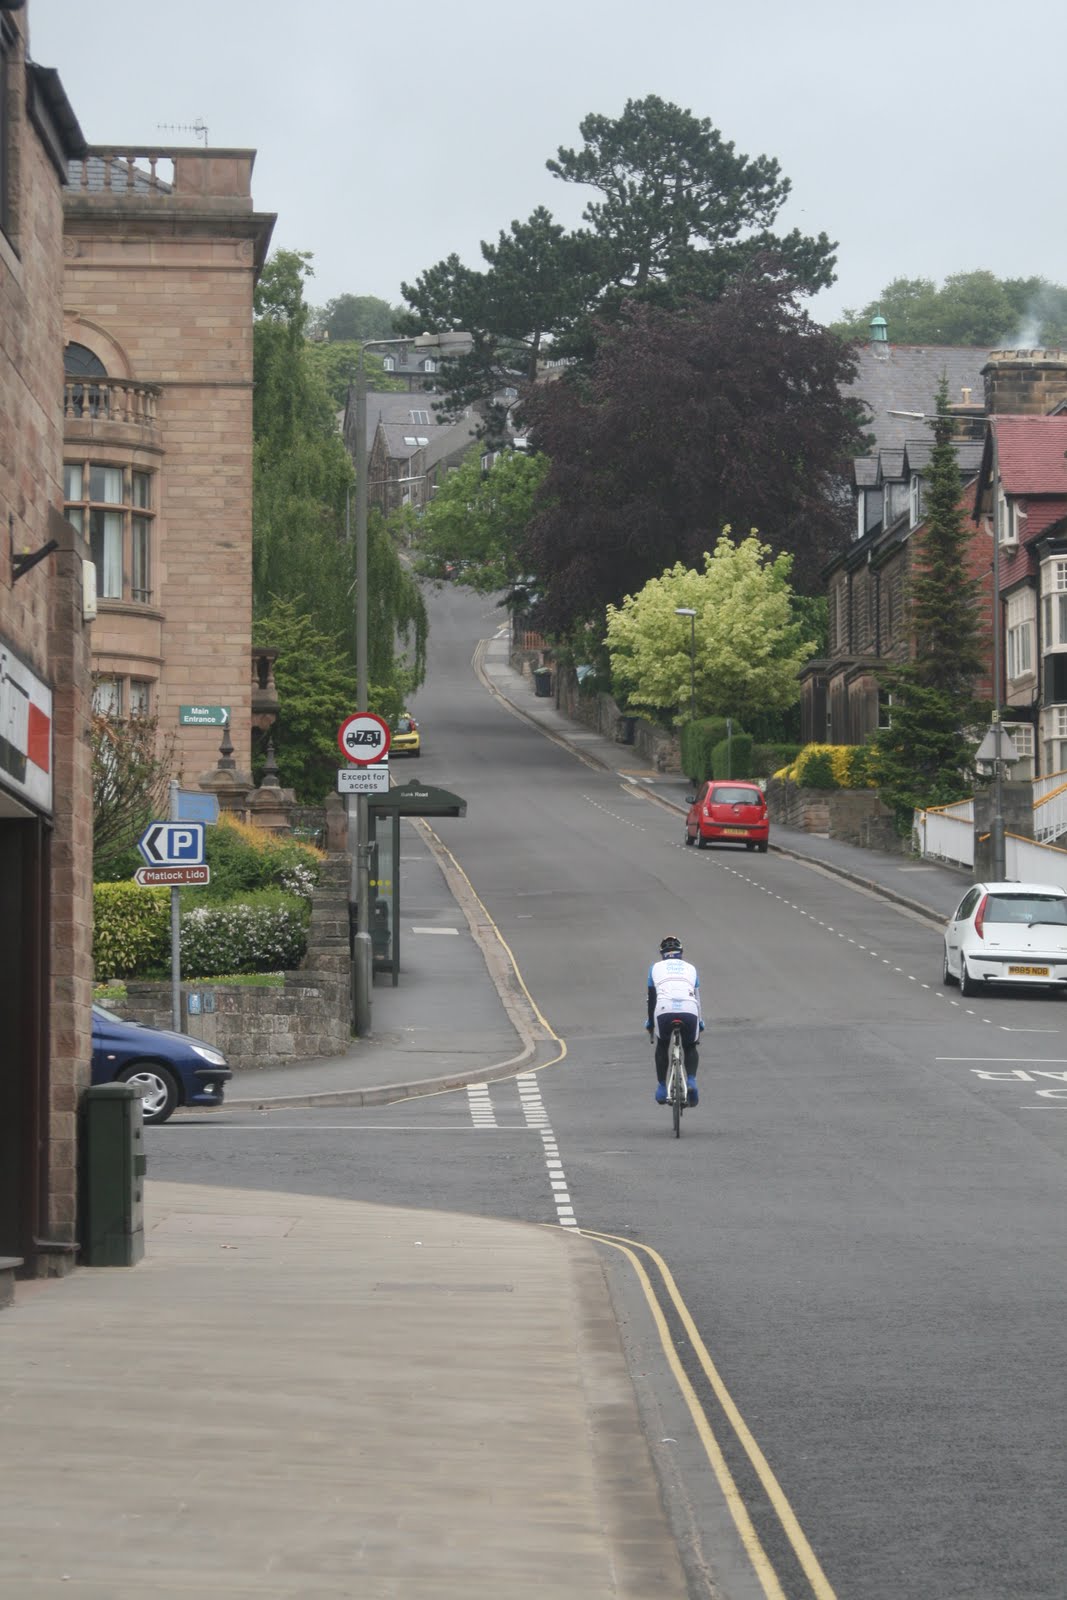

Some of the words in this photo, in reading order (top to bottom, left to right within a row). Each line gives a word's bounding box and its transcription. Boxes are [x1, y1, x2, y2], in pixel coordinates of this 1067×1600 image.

[191, 707, 209, 715] Main
[183, 715, 216, 723] Entrance
[341, 773, 371, 781] Except
[173, 831, 193, 857] P
[146, 870, 183, 881] Matlock
[186, 870, 205, 880] Lido
